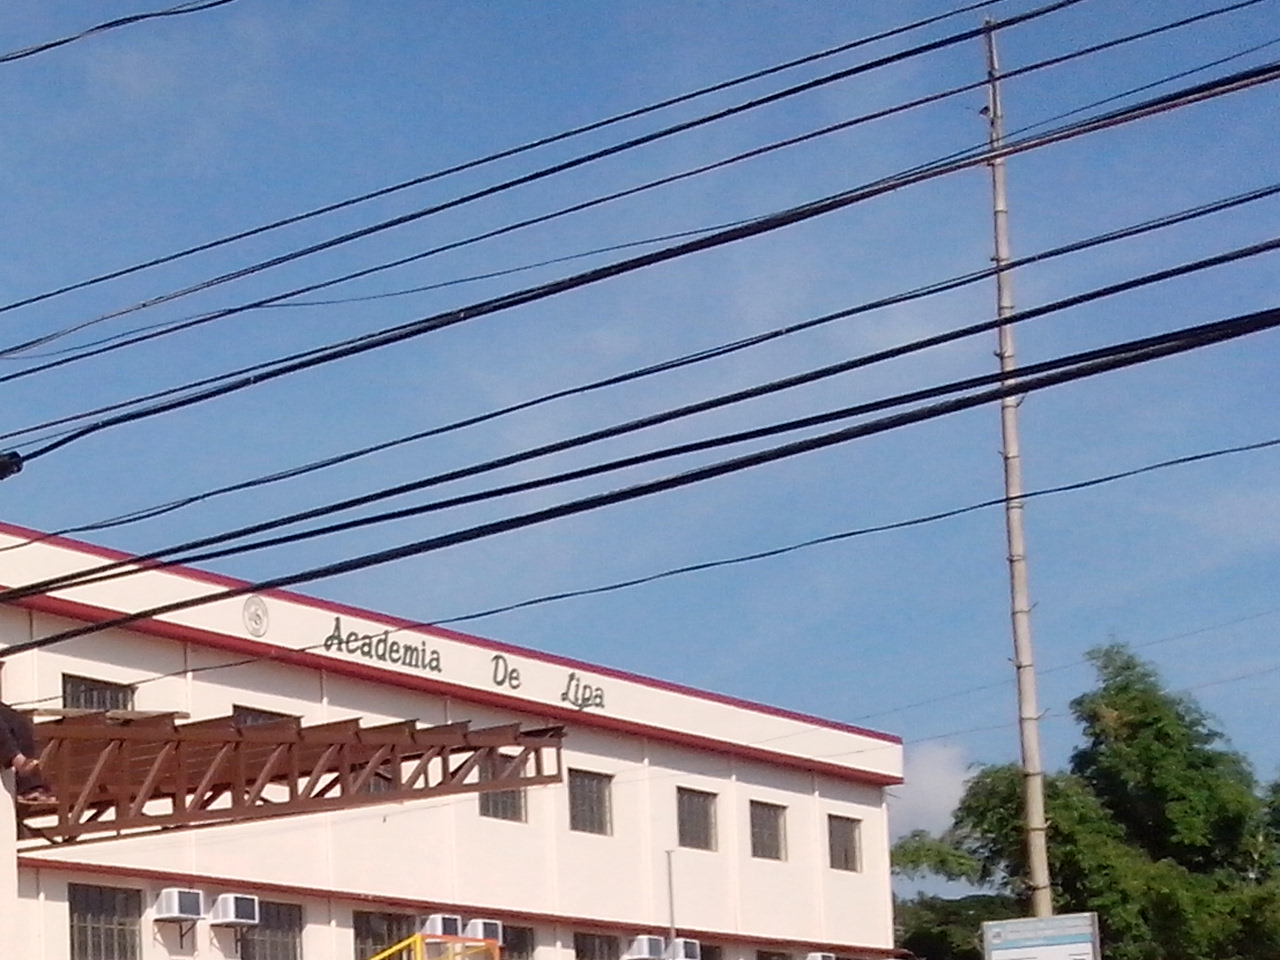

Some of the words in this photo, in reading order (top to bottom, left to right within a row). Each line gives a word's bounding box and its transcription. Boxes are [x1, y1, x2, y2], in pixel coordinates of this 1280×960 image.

[324, 617, 443, 673] Academia
[492, 655, 522, 690] De
[561, 672, 606, 712] Lipa
